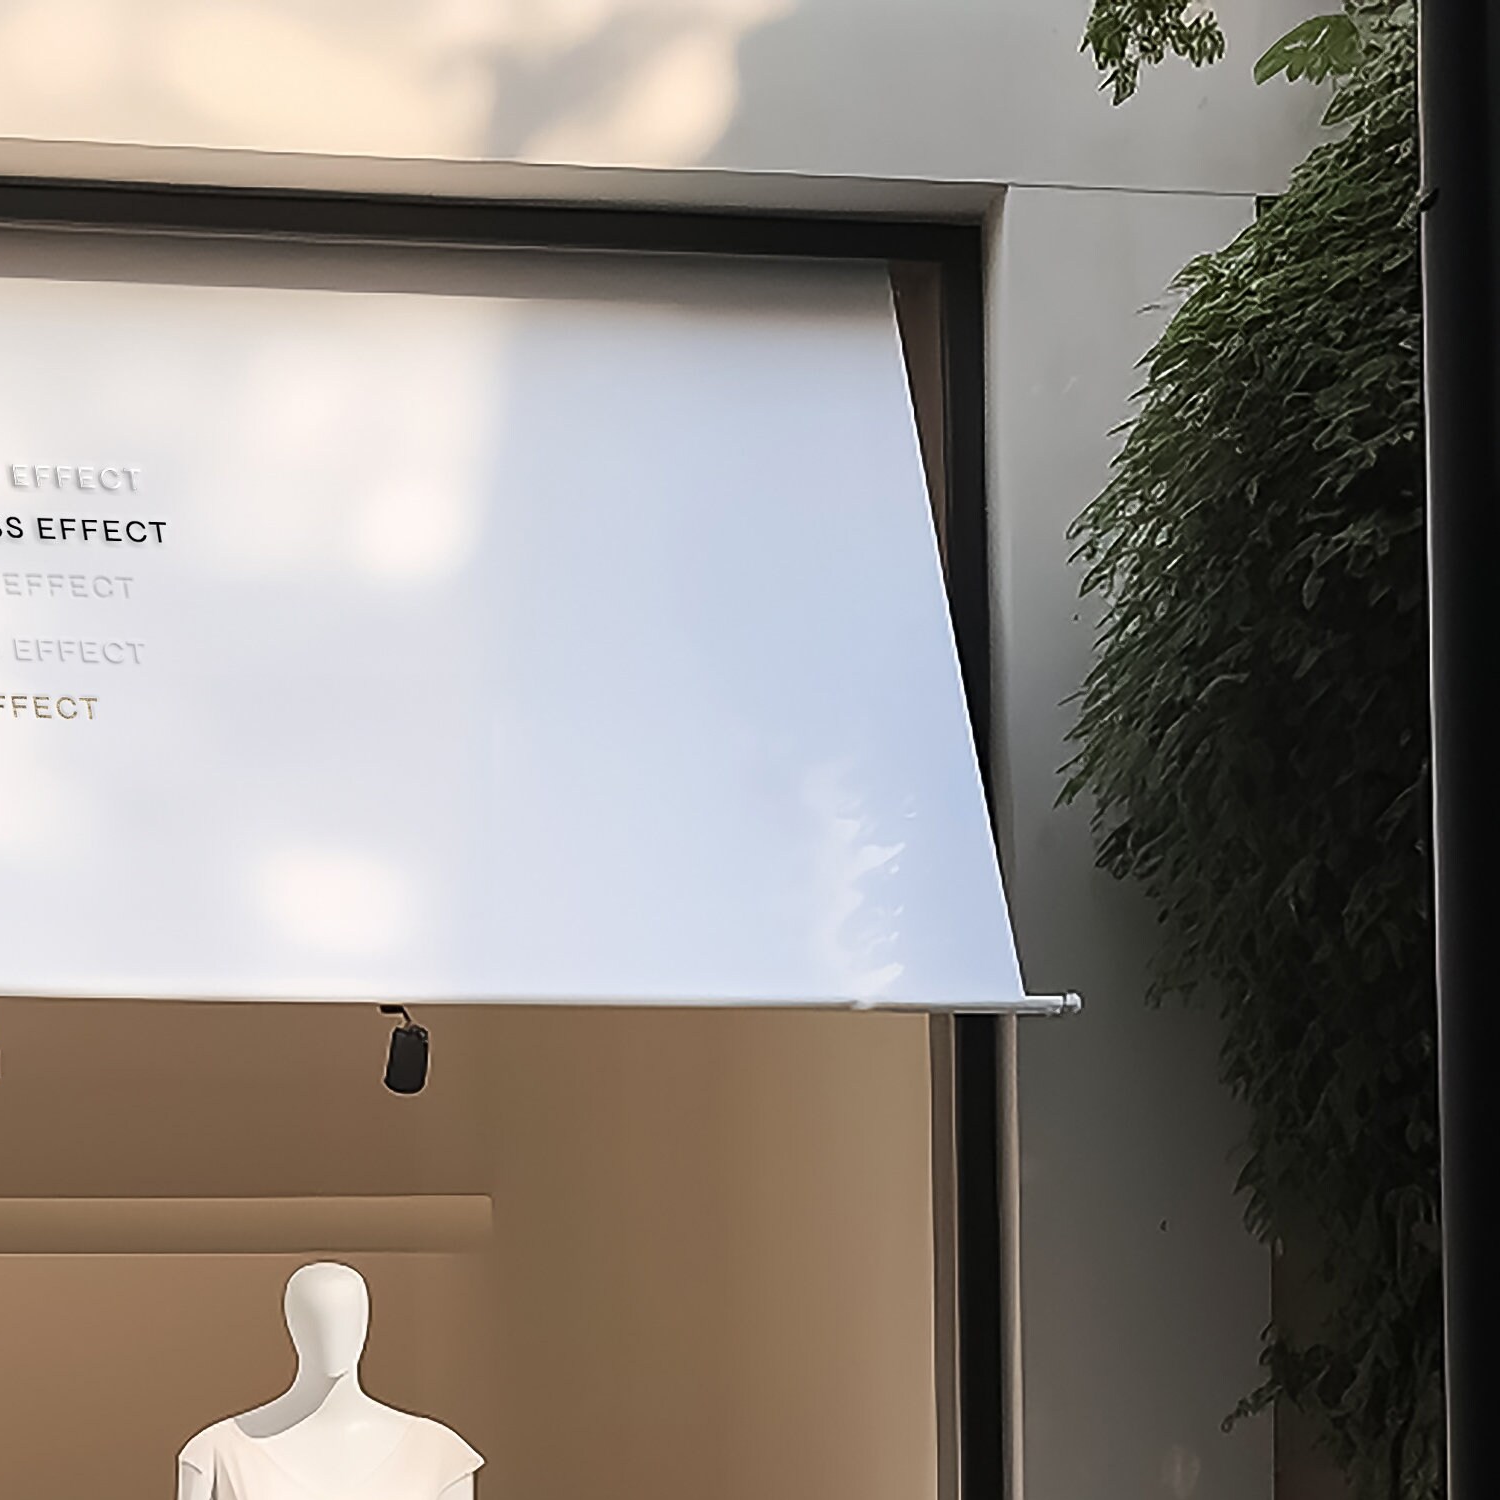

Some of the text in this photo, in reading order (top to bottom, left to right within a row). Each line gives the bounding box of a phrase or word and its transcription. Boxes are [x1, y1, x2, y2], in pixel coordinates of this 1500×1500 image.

[11, 464, 142, 491] EFFECT
[36, 517, 167, 543] EFFECT
[3, 572, 134, 599] EFFECT
[13, 638, 145, 664] EFFECT
